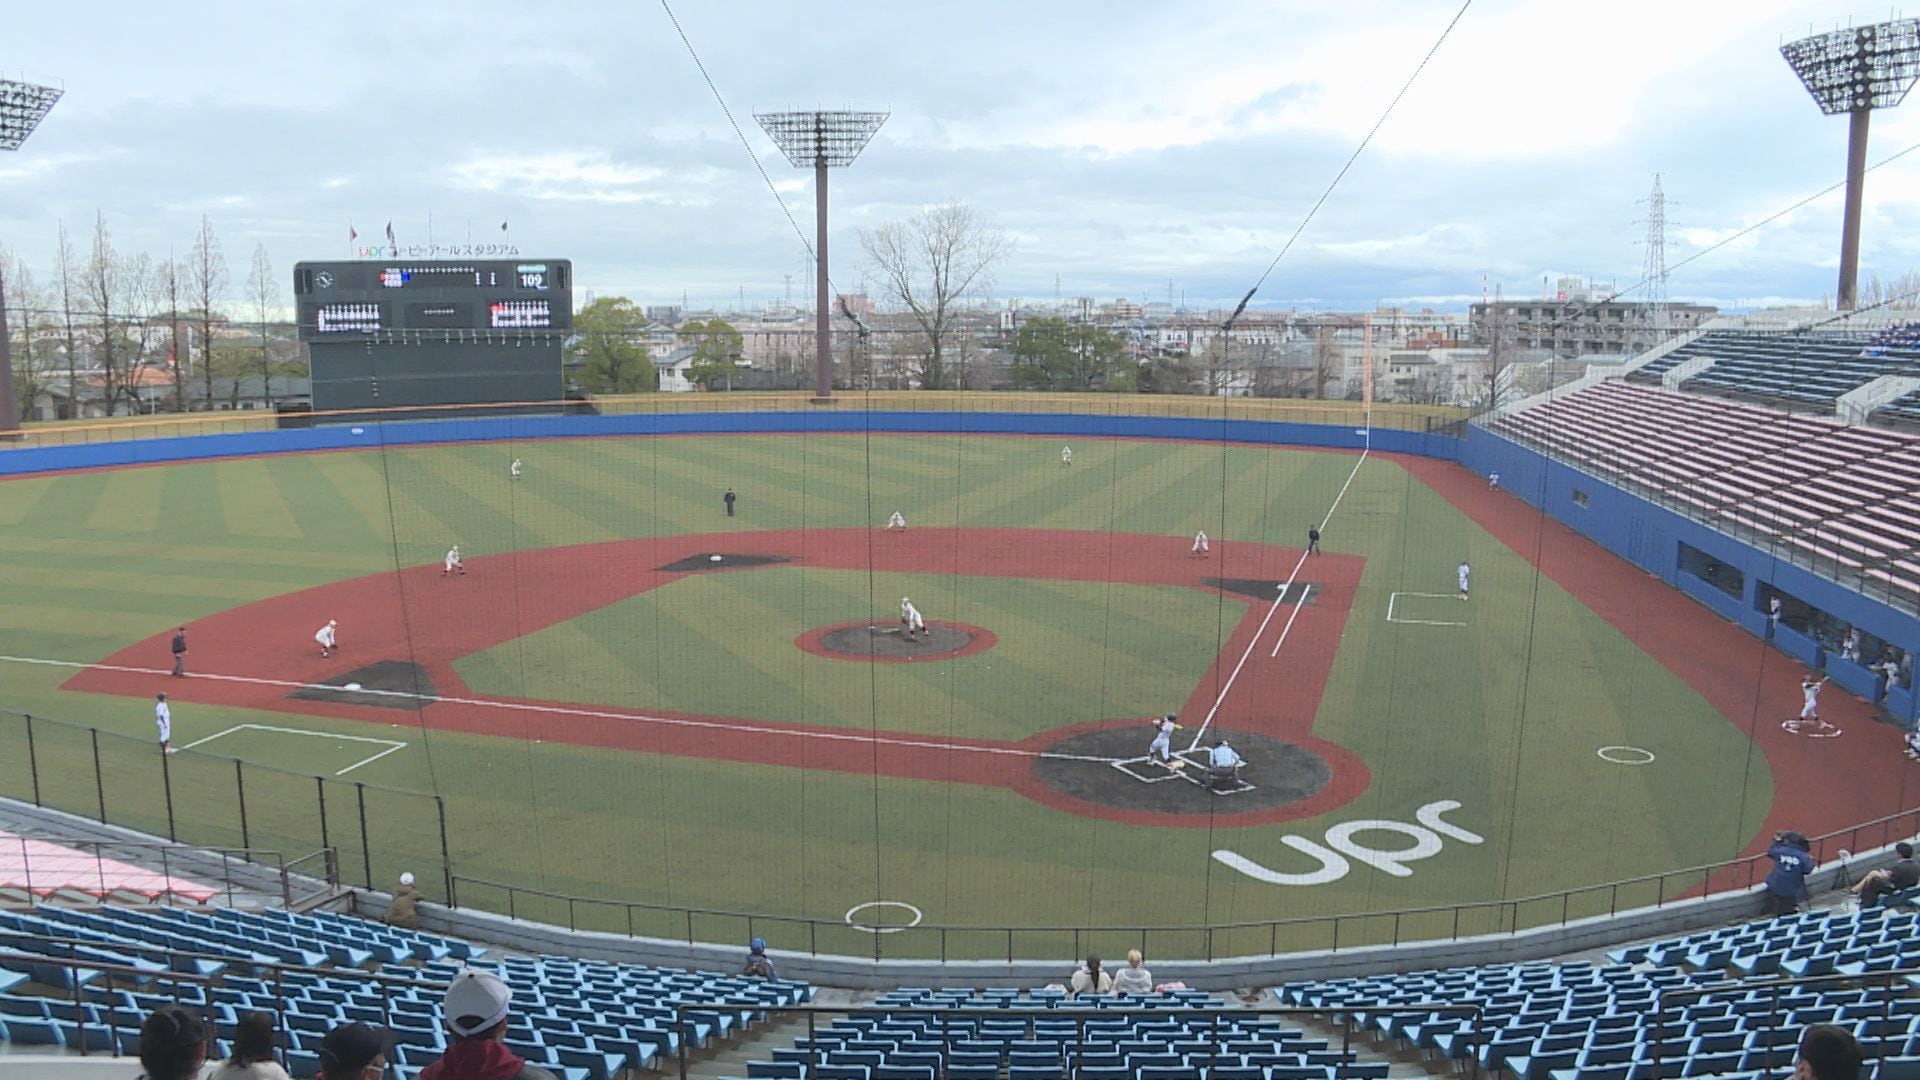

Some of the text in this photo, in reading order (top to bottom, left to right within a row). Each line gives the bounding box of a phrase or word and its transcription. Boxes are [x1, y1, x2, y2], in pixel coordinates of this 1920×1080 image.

[359, 246, 385, 257] upr
[520, 274, 543, 287] 109
[1211, 800, 1485, 886] upr
